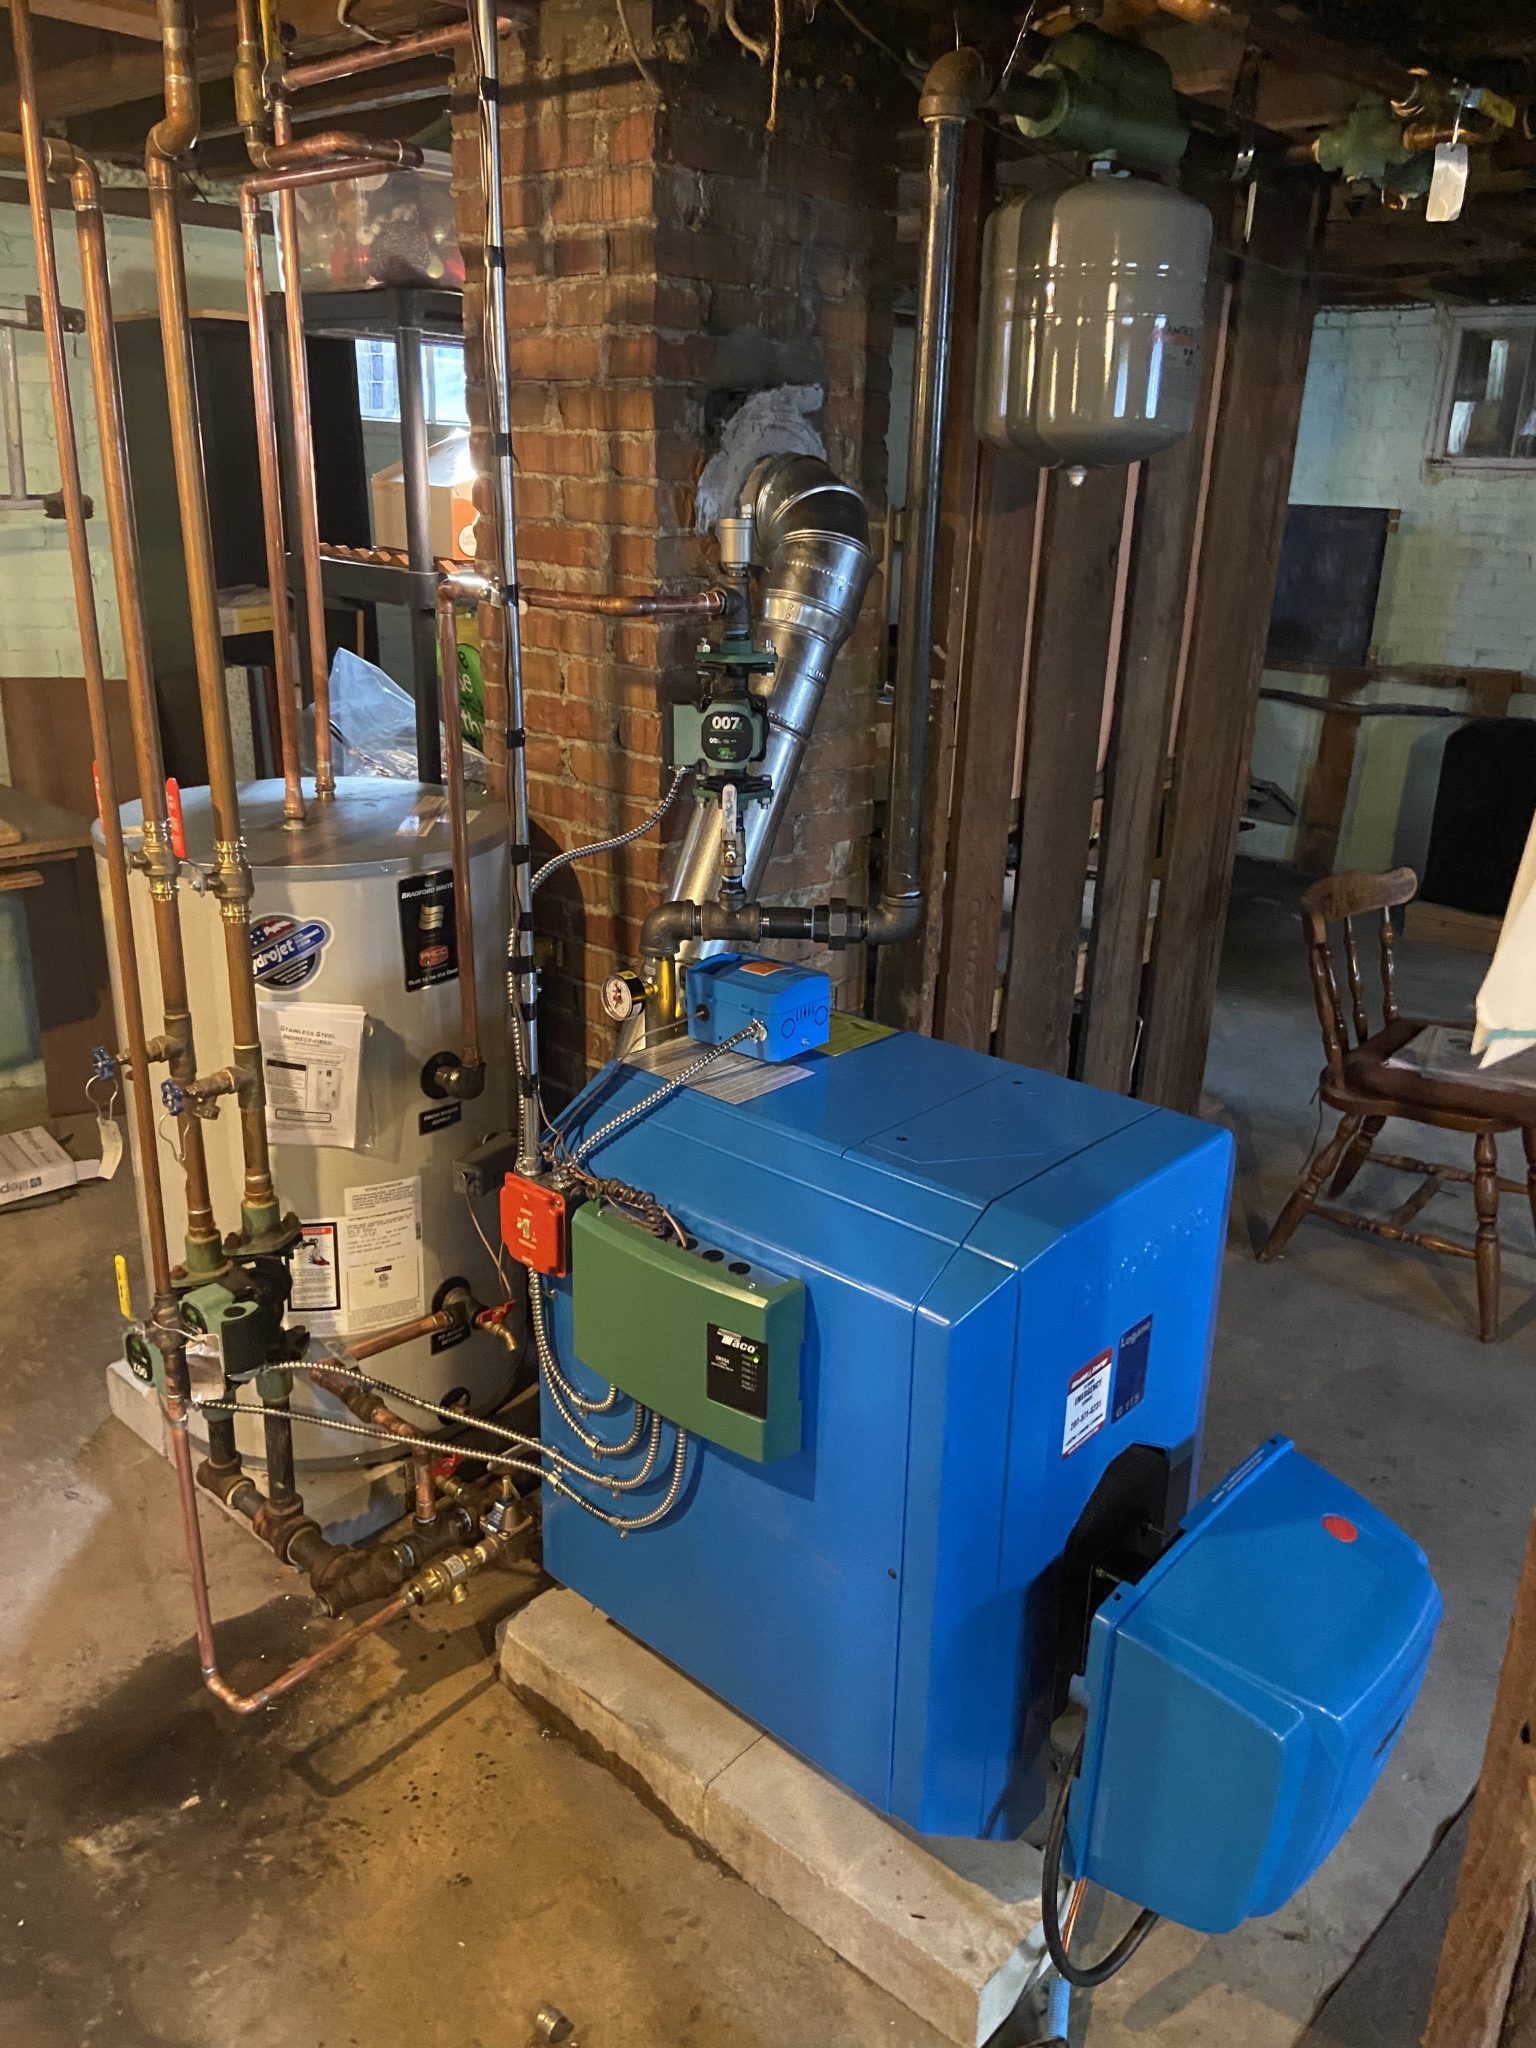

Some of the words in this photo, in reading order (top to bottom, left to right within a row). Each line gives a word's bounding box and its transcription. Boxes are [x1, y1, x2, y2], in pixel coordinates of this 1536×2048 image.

[401, 887, 435, 899] BRADFORD
[253, 939, 294, 975] ydrojet
[717, 1328, 756, 1354] Taco
[1074, 1377, 1103, 1406] EMERGENCY
